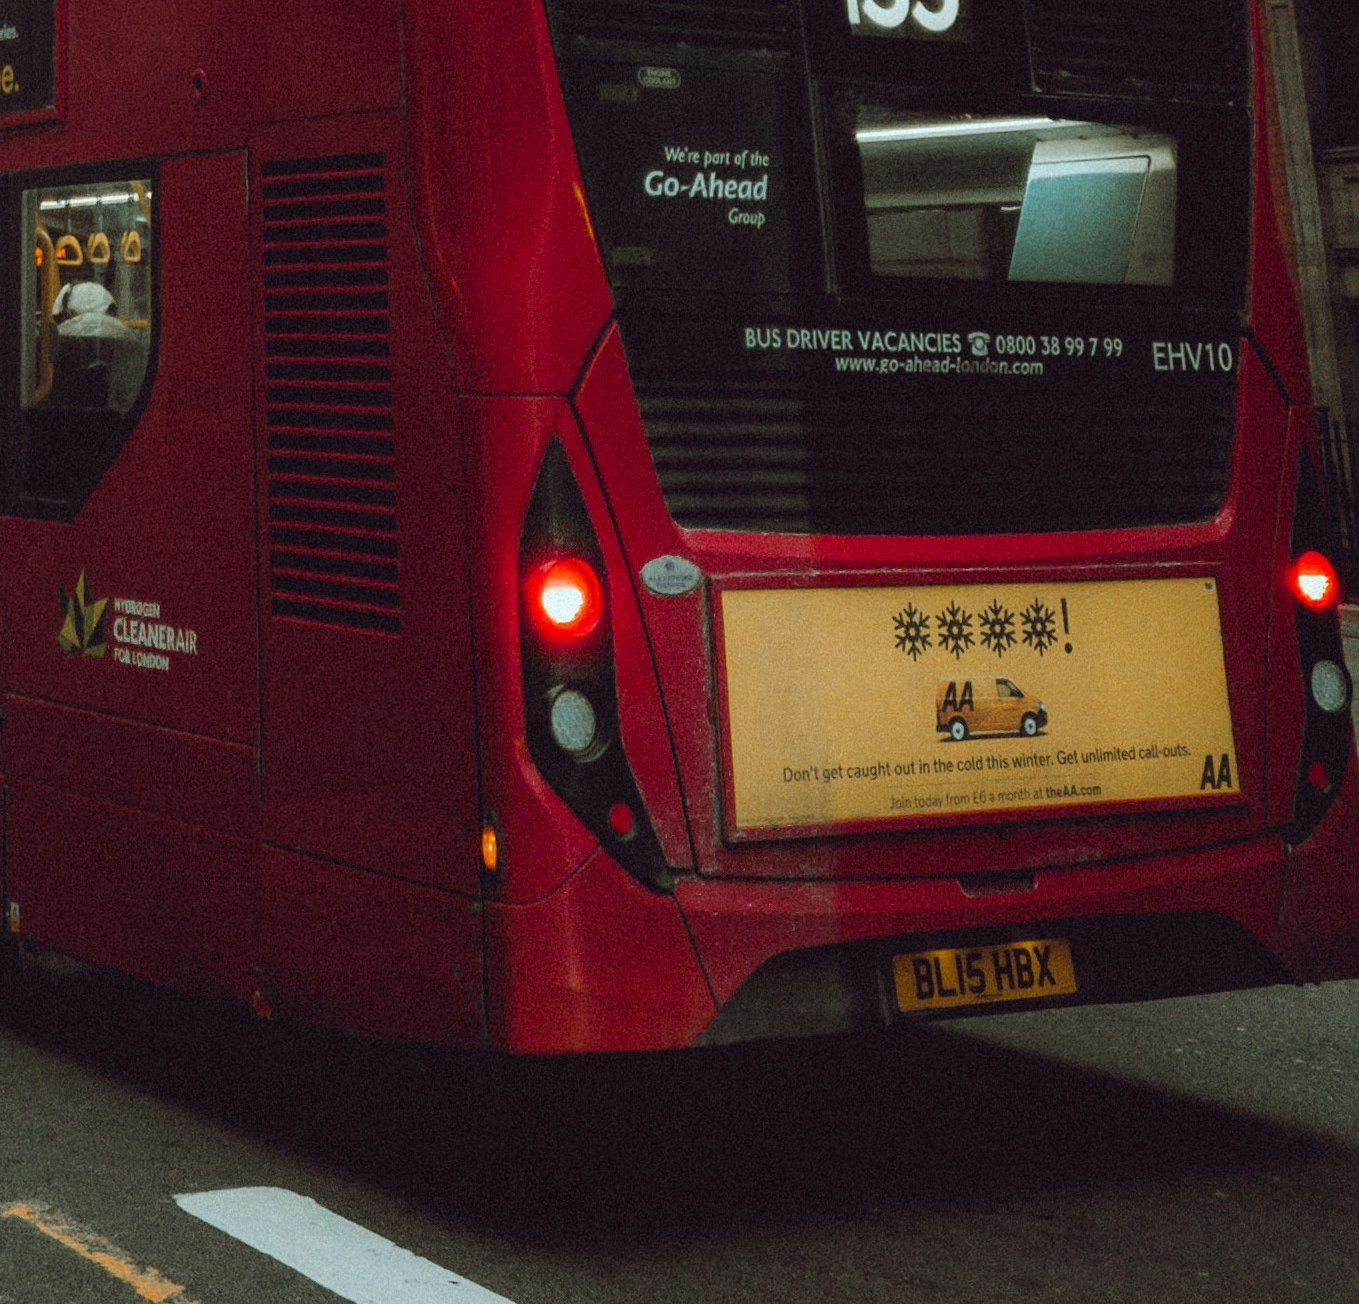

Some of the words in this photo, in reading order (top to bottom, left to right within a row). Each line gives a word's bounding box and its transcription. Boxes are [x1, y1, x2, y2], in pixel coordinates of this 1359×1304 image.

[664, 146, 700, 165] We're
[703, 150, 730, 169] part
[734, 149, 749, 170] of
[750, 151, 770, 168] the
[644, 170, 768, 201] Go-Ahead
[728, 207, 766, 230] Group
[744, 328, 782, 350] BUS
[786, 328, 854, 350] DRIVER
[857, 331, 962, 353] VACANCIES
[995, 335, 1036, 356] 0800
[1039, 335, 1061, 356] 38
[1064, 336, 1084, 357] 99
[1088, 337, 1099, 357] 7
[1102, 338, 1123, 358] 99
[1151, 342, 1233, 372] EHV10
[834, 356, 1044, 375] www.go-ahead-london.com
[114, 647, 131, 665] FOR
[132, 651, 170, 672] LONDON
[941, 681, 974, 712] AA
[783, 767, 820, 783] Don't
[822, 765, 843, 783] get
[846, 762, 891, 781] caught
[893, 761, 915, 776] out
[918, 759, 930, 774] in
[932, 757, 954, 773] the
[956, 755, 984, 771] cold
[986, 752, 1010, 769] this
[1012, 749, 1054, 769] winter.
[1056, 749, 1079, 766] Get
[1081, 745, 1136, 765] unlimited
[1138, 742, 1192, 761] call-outs.
[1200, 753, 1232, 791] AA
[890, 797, 913, 810] Join
[914, 795, 944, 811] today
[945, 793, 971, 807] from
[998, 790, 1031, 803] month
[1033, 789, 1044, 800] at
[1046, 785, 1102, 800] theAA.com
[912, 953, 986, 1000] BL15
[991, 945, 1056, 993] HBX
